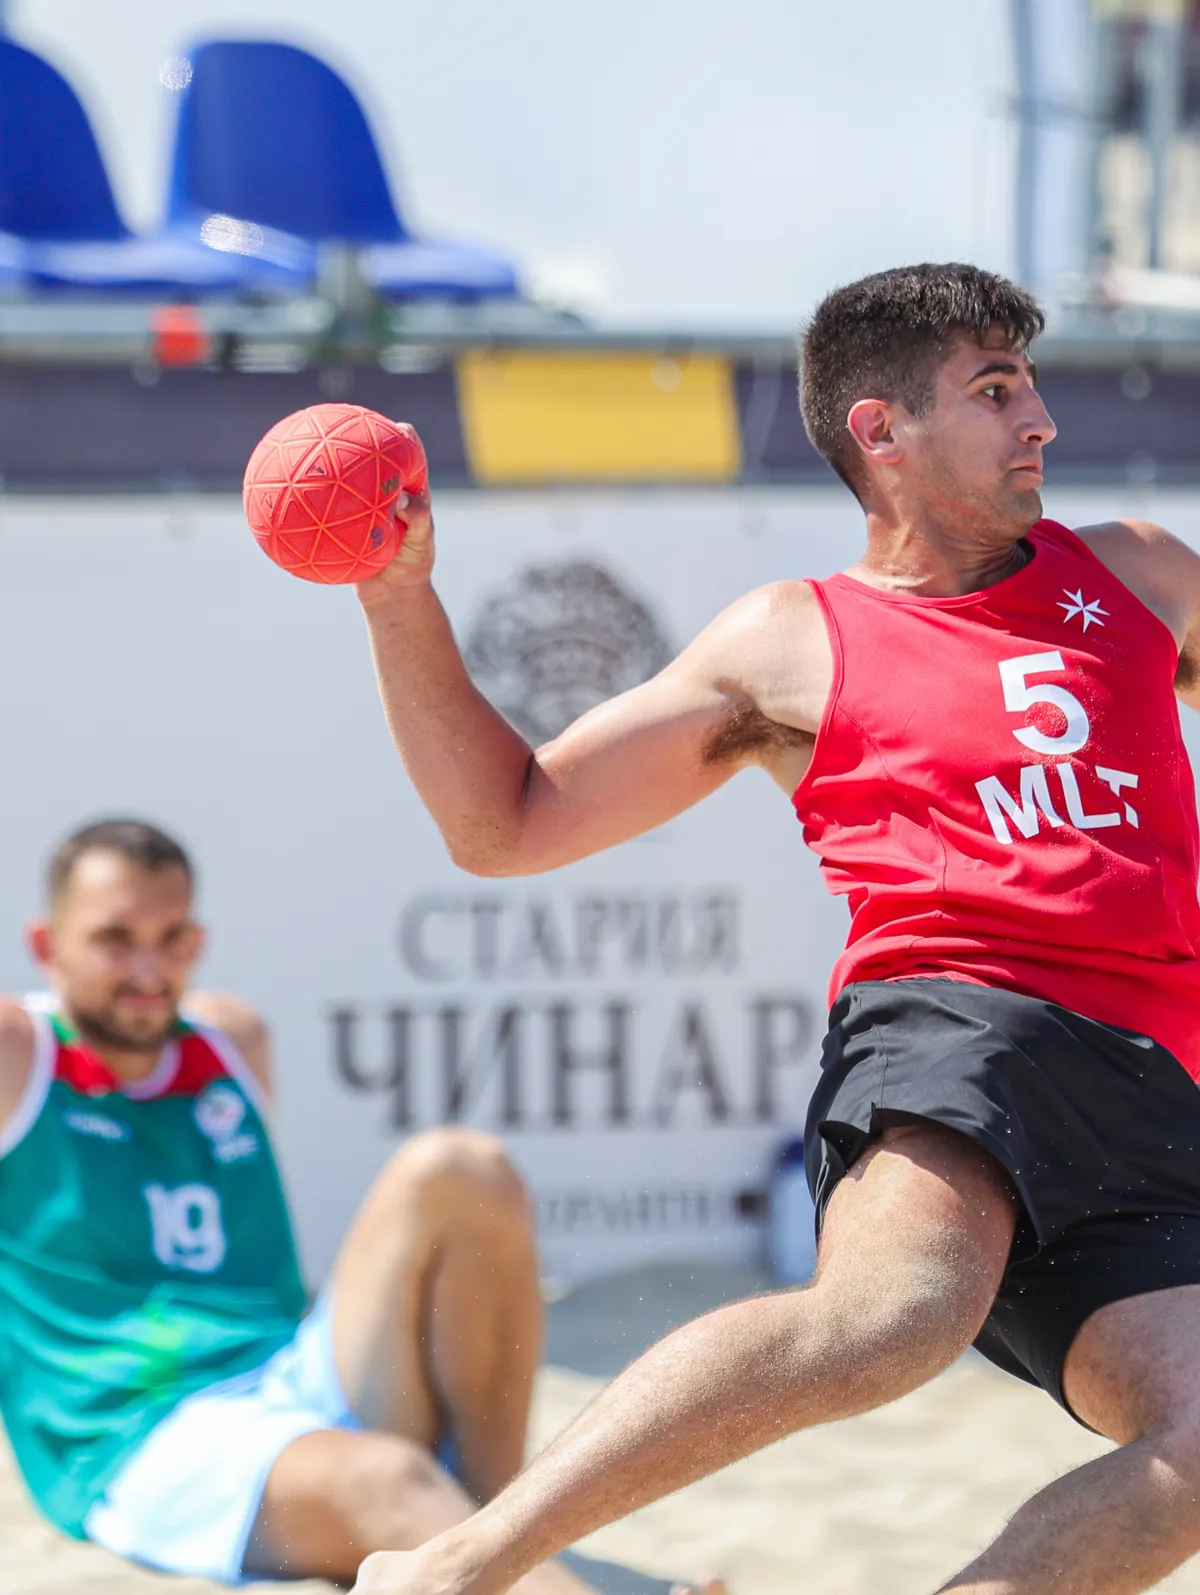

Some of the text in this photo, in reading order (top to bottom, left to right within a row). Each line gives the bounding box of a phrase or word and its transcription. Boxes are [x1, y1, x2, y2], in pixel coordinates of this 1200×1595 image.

[998, 651, 1090, 755] 5
[974, 762, 1139, 844] MLT
[398, 889, 743, 982] СТАРИЯ
[329, 997, 814, 1134] ЧИНАР
[142, 1182, 227, 1274] 19
